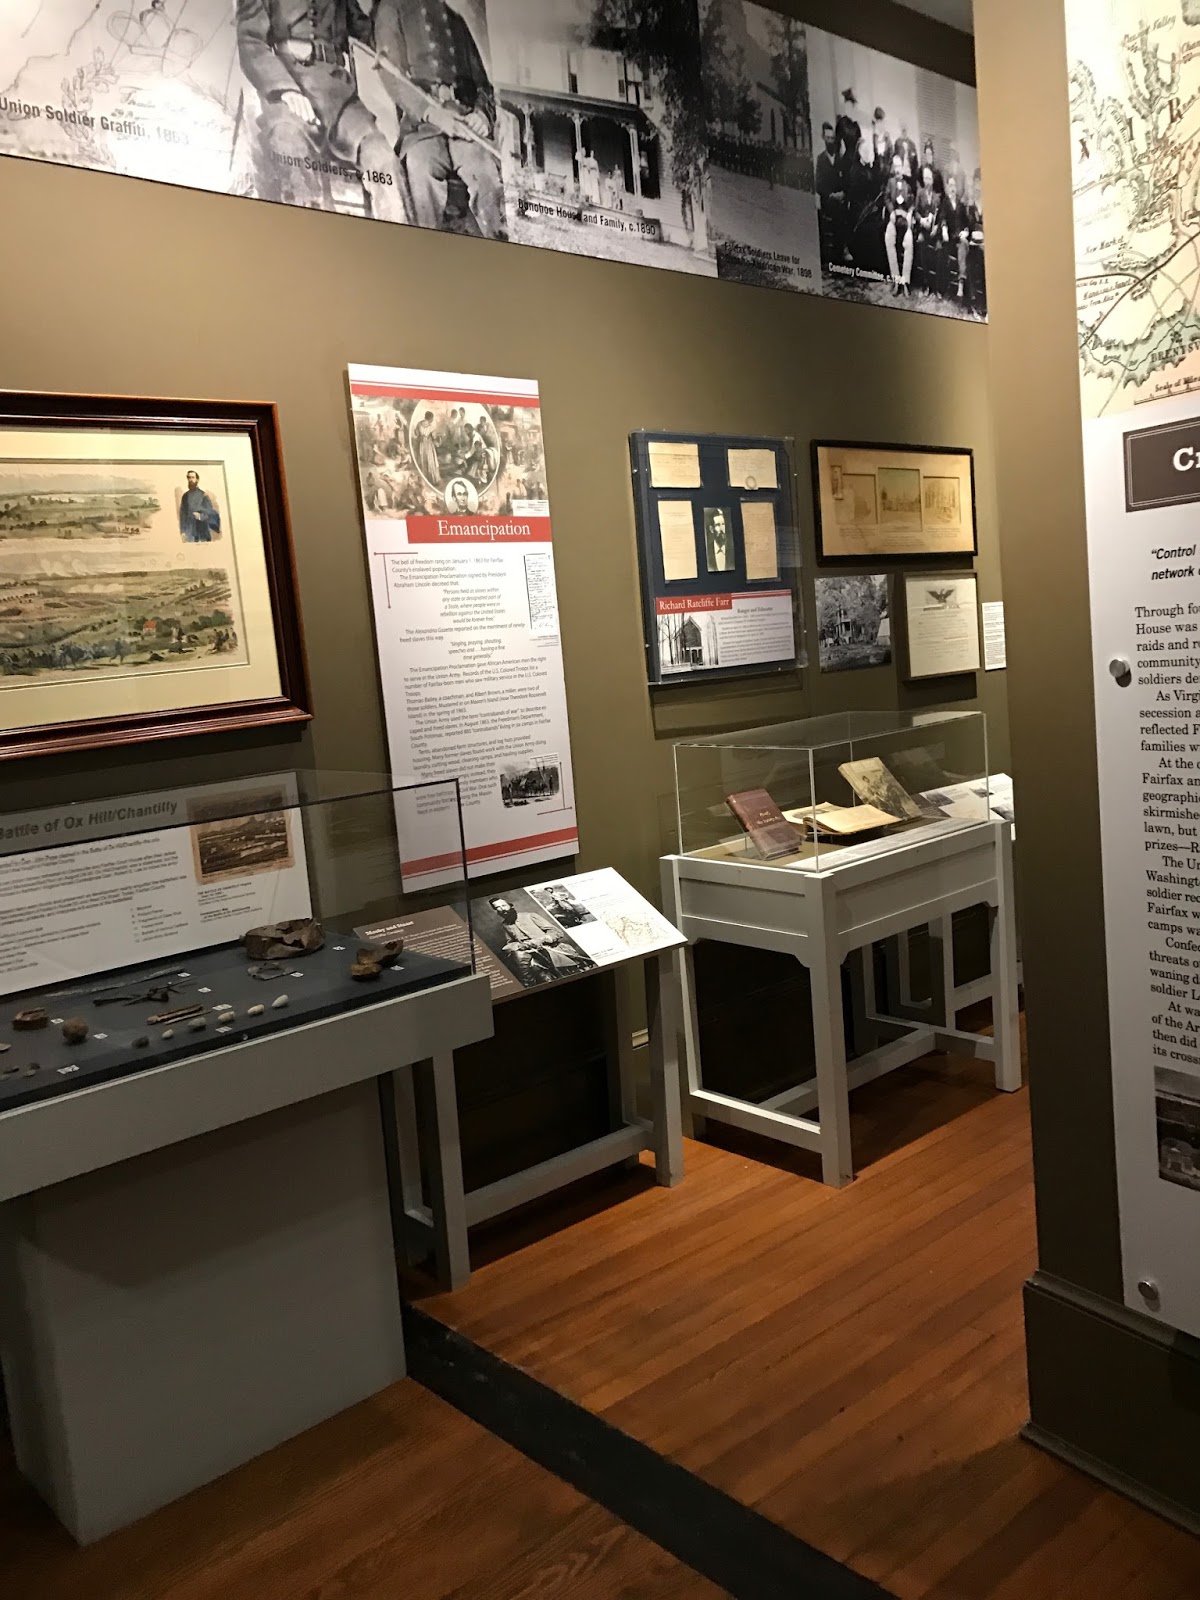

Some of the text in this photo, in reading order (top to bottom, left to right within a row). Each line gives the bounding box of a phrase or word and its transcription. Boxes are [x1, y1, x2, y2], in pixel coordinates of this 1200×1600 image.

[0, 97, 40, 118] Union
[45, 105, 95, 128] Soldier
[100, 116, 150, 139] Graffiti,
[583, 213, 598, 225] and
[600, 215, 627, 232] Family,
[628, 222, 656, 236] c.1890
[773, 251, 791, 264] Leave
[791, 255, 800, 265] for
[797, 267, 813, 279] 1898
[828, 262, 855, 278] Cemetery
[437, 519, 531, 541] Emancipation
[1151, 565, 1195, 580] network
[659, 597, 731, 611] Richard Ratcliffe Farr
[1134, 603, 1185, 619] Through
[1135, 623, 1198, 635] House was
[1136, 637, 1189, 651] raids and
[1137, 655, 1200, 669] community
[1138, 672, 1200, 685] soldiers de
[1156, 690, 1171, 701] As
[1139, 707, 1192, 719] secession
[1140, 723, 1189, 735] reflected
[1140, 739, 1186, 752] families
[1158, 756, 1194, 769] At the
[1142, 772, 1184, 785] Fairfax
[1142, 791, 1200, 805] geographi
[43, 817, 59, 833] of
[64, 816, 84, 830] Ox
[88, 801, 178, 826] Hill/Chantilly
[1143, 805, 1200, 820] skirmishe
[1144, 821, 1198, 837] lawn, but
[1162, 855, 1184, 868] The
[1146, 887, 1183, 901] soldier
[1147, 901, 1188, 918] Fairfax
[1147, 920, 1183, 934] camps
[1149, 950, 1190, 967] threats
[1150, 968, 1190, 985] waning
[1150, 983, 1188, 998] soldier
[1168, 1001, 1182, 1013] At
[1151, 1014, 1164, 1025] of
[1165, 1015, 1183, 1029] the
[1152, 1029, 1198, 1048] then did
[1152, 1043, 1167, 1057] its
